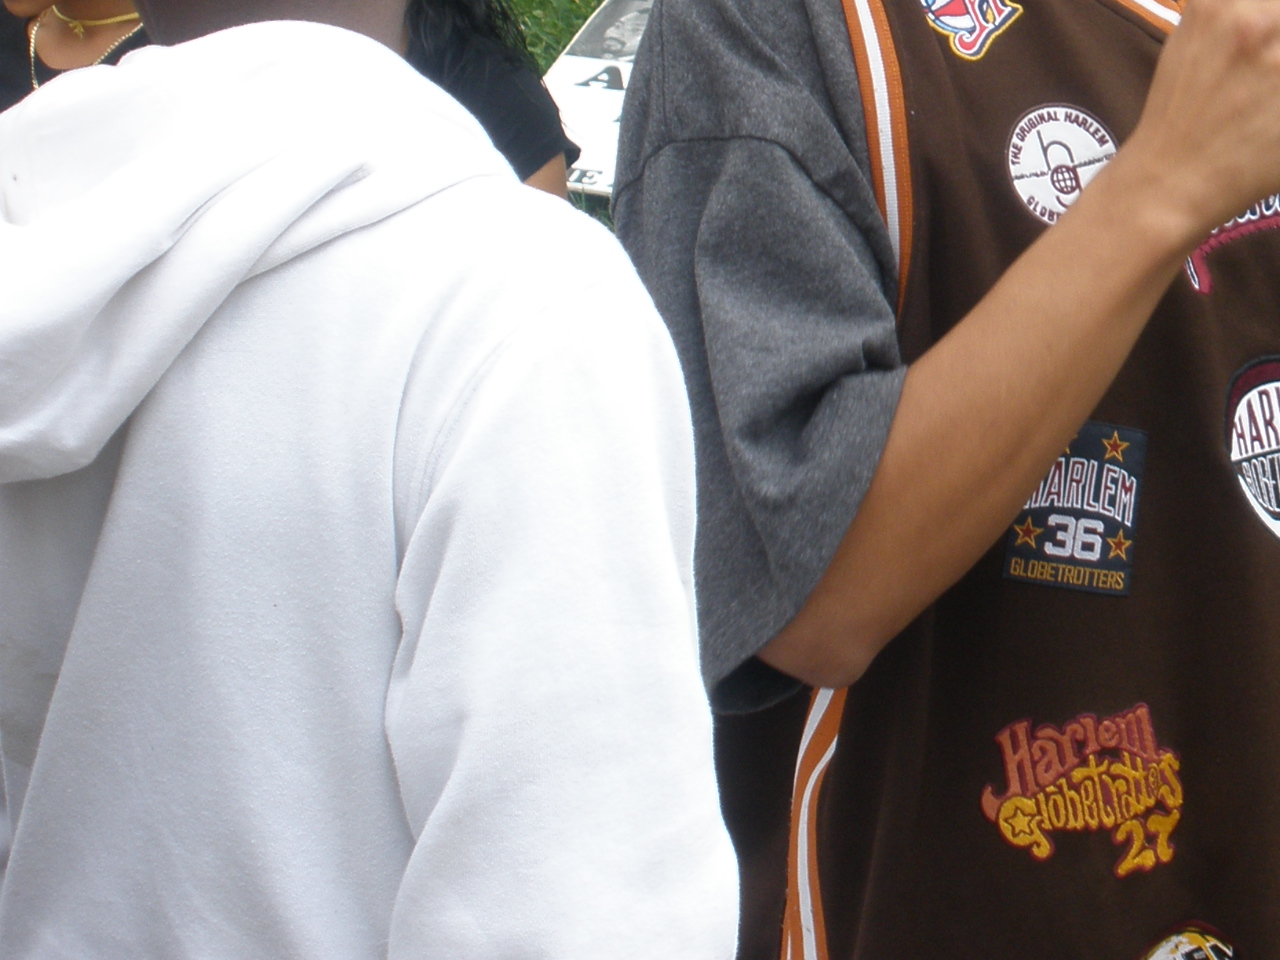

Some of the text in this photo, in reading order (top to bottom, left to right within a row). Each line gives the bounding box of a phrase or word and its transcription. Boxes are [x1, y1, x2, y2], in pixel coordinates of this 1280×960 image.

[1010, 110, 1110, 166] THE ORIGINAL HARLEM
[1026, 195, 1060, 222] GLOB
[1043, 513, 1105, 562] 36
[1010, 557, 1125, 590] GLOBETROTTERS
[981, 704, 1159, 822] Harlem
[1116, 809, 1180, 876] 27
